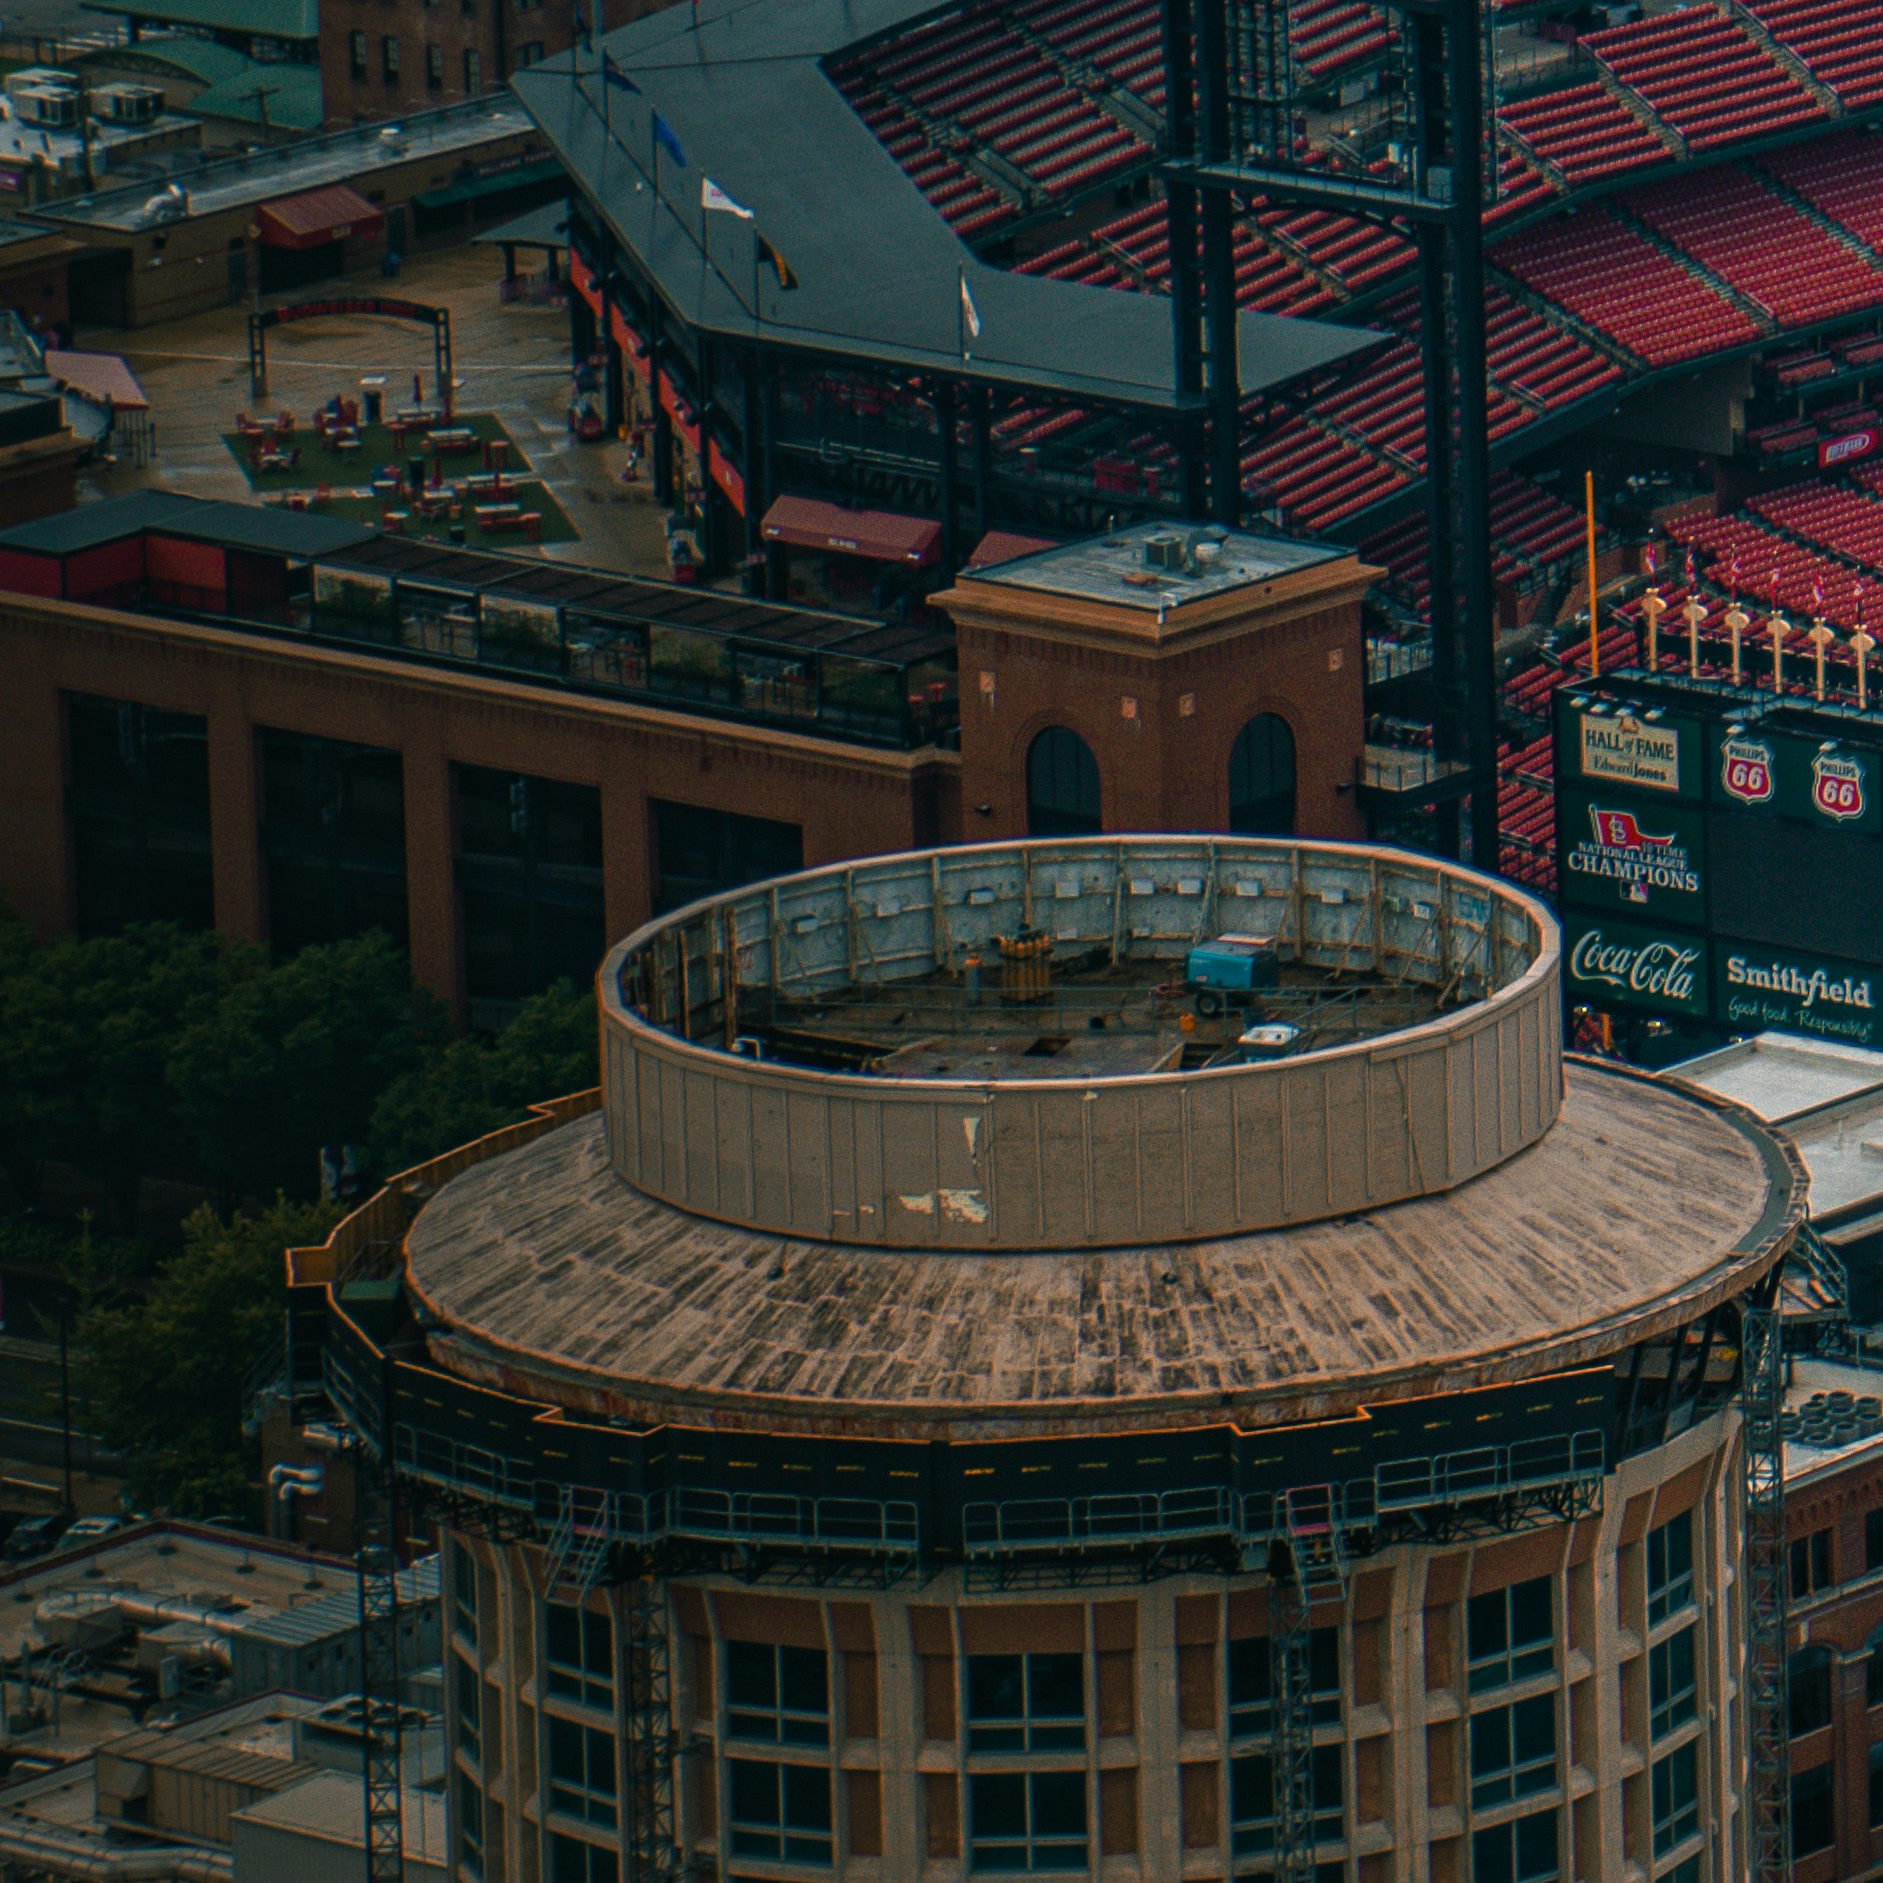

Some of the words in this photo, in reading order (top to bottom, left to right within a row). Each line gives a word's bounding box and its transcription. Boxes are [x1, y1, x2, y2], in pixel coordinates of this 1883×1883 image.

[1585, 728, 1625, 751] HALL
[1636, 738, 1675, 760] FAME
[1729, 744, 1767, 761] PHILLIPS
[1732, 762, 1764, 790] 66
[1820, 761, 1858, 778] PHILLIPS
[1823, 779, 1855, 807] 66
[1577, 841, 1637, 861] NATIONAL
[1639, 850, 1688, 870] LEAGUE
[1567, 851, 1700, 892] CHAMPIONS
[1570, 928, 1701, 1000] Coca-Cola
[1727, 956, 1873, 1009] Smithfield
